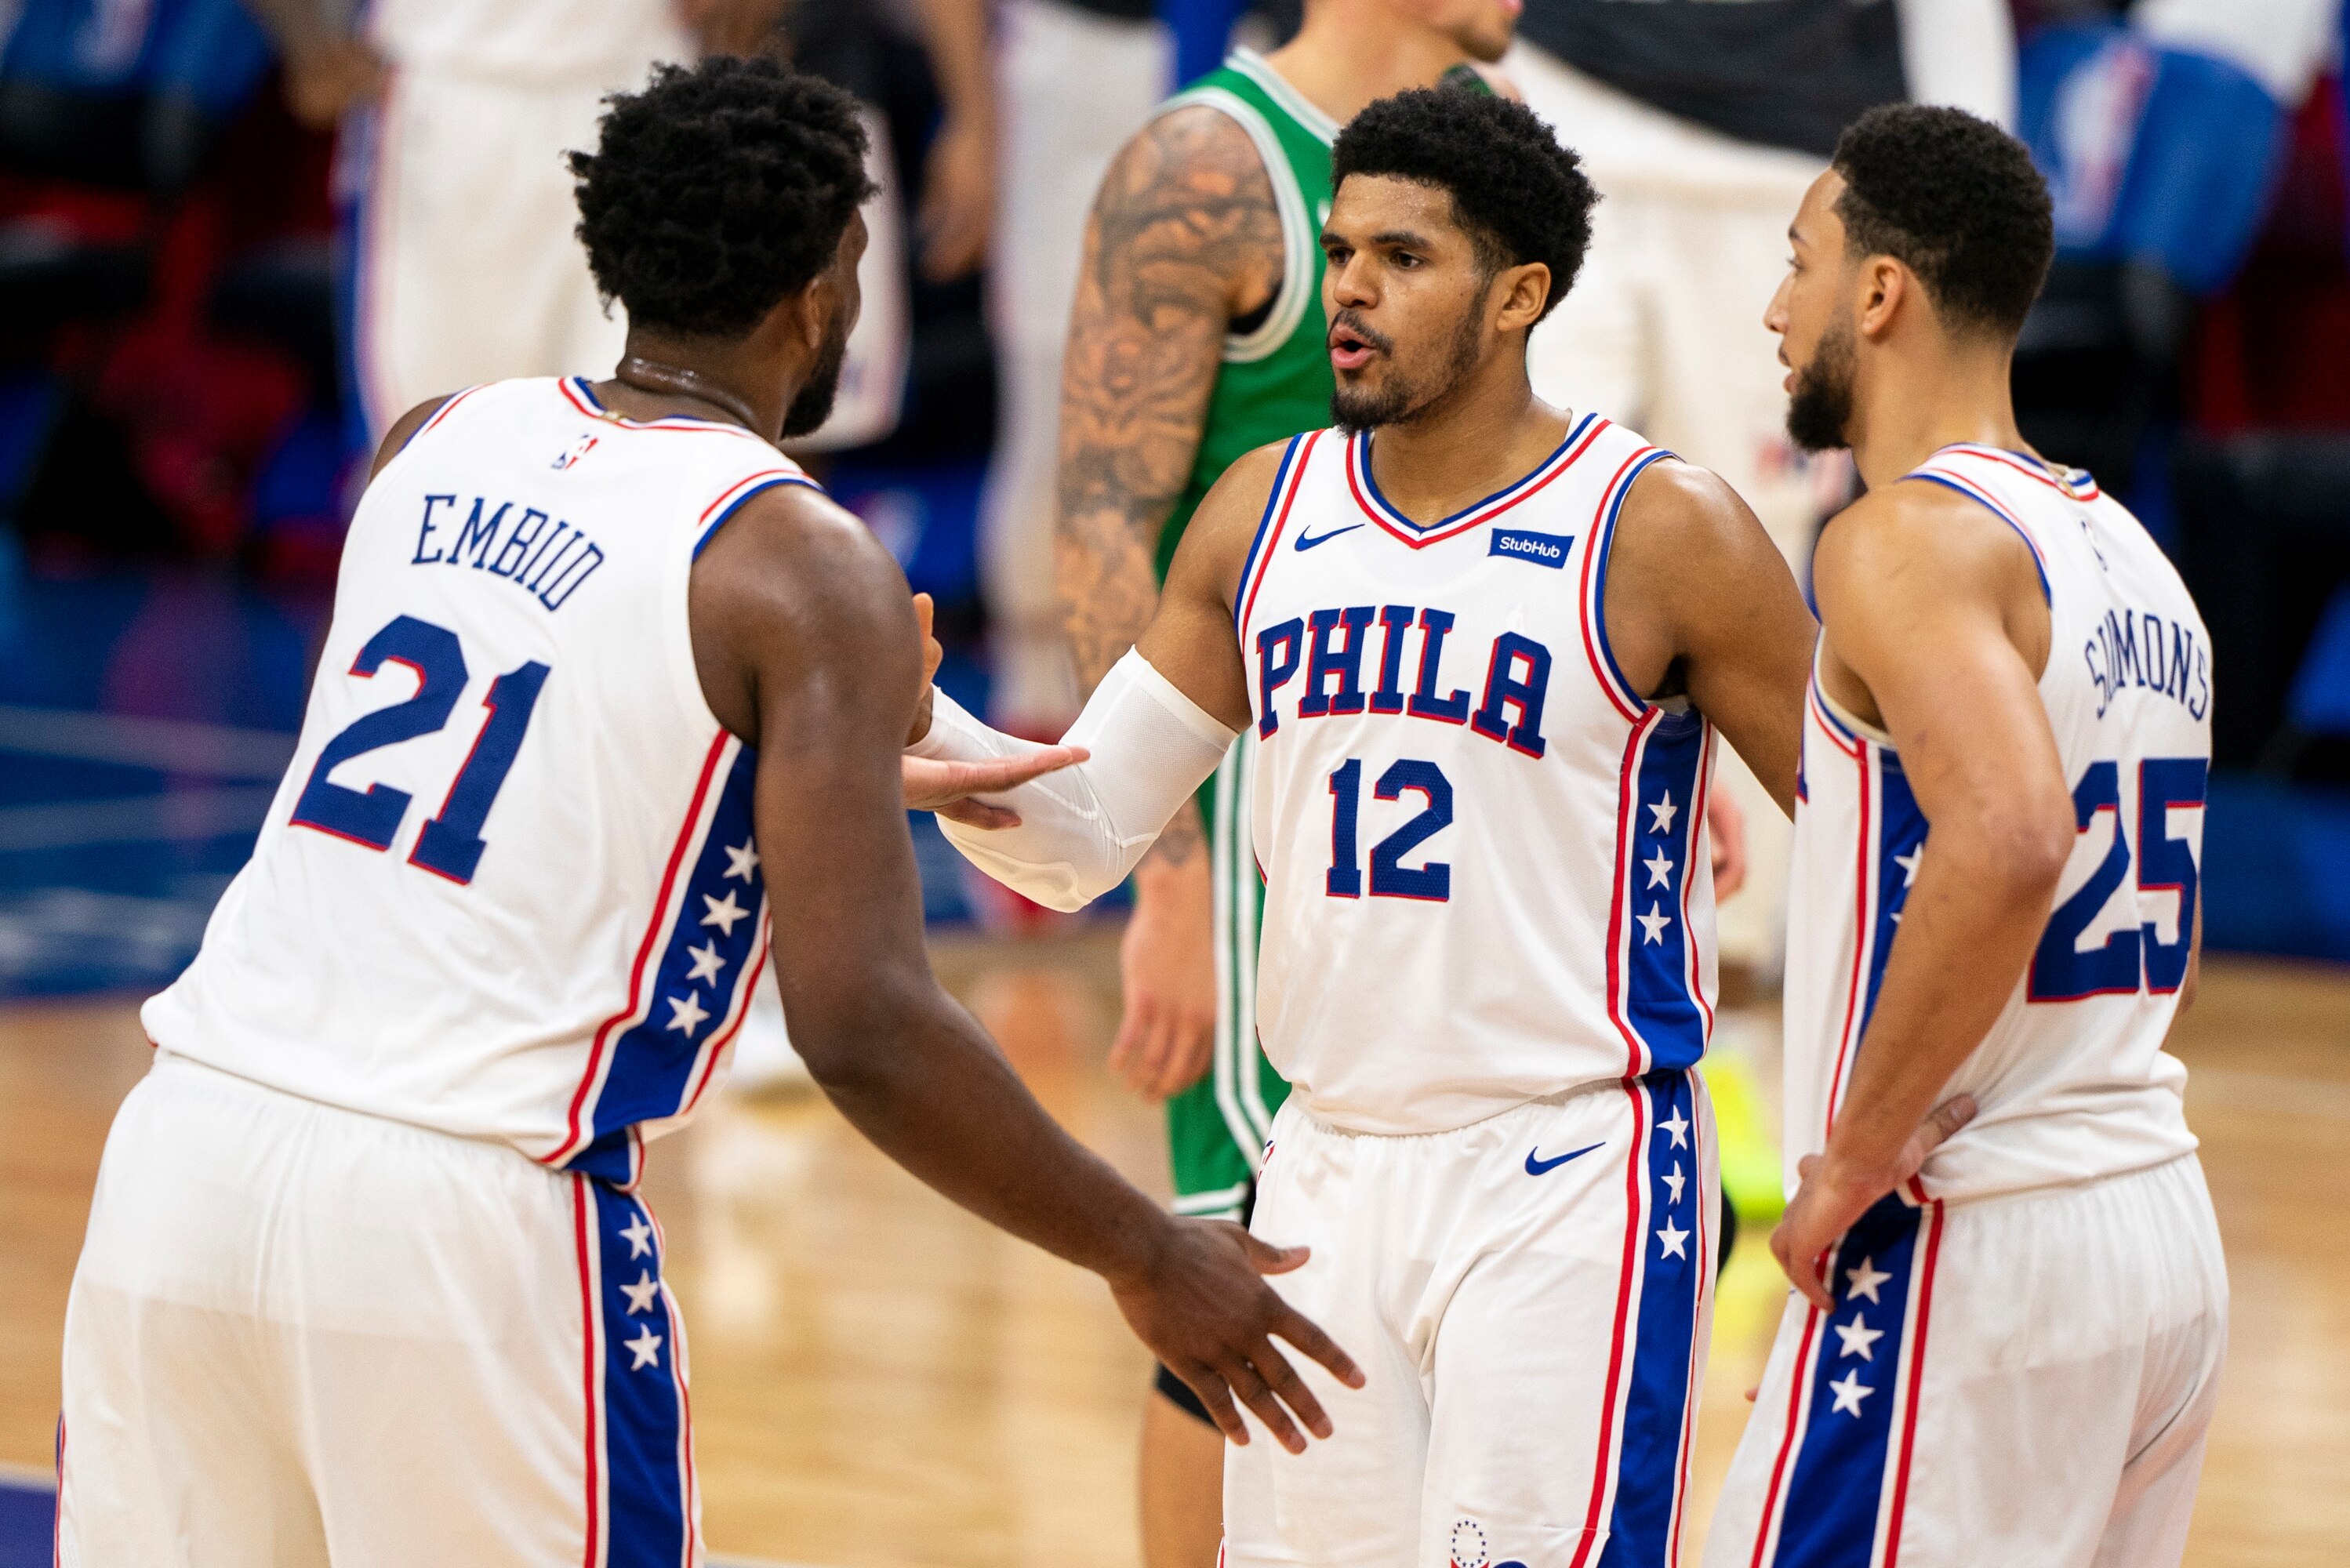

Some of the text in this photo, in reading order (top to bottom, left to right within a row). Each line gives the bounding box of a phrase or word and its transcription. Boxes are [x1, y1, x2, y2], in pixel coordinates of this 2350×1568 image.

[411, 494, 605, 612] EMBIID
[1499, 536, 1560, 558] StubHub
[289, 614, 551, 886] 21
[1256, 604, 1553, 760] PHILA
[1326, 758, 1453, 902] 12
[2026, 757, 2210, 1004] 25
